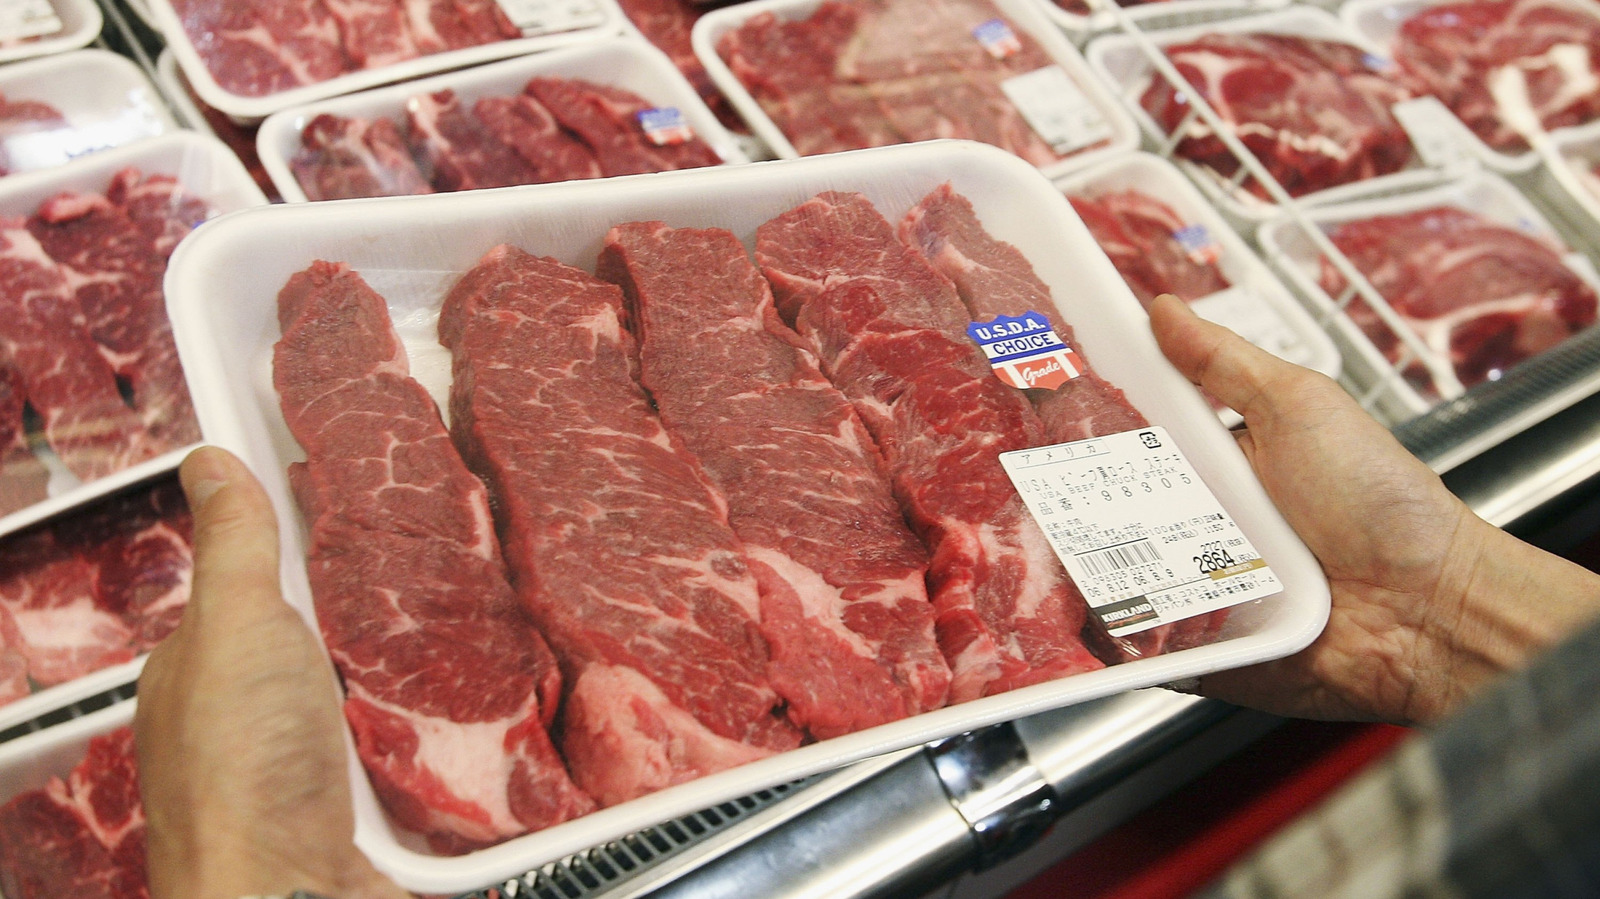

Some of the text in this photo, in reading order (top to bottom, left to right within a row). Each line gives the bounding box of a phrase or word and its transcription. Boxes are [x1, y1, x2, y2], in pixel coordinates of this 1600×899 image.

[975, 318, 1046, 340] U.S.D.A.
[993, 334, 1054, 354] CHOICE
[1022, 361, 1060, 385] Grade
[1020, 443, 1096, 464] アメリカ
[1019, 478, 1052, 493] USA
[1038, 466, 1178, 499] USA BEEF CHUCK STEAK
[1200, 541, 1224, 555] 2727
[1193, 549, 1238, 574] 2864
[1101, 603, 1153, 623] KIRKLAND
